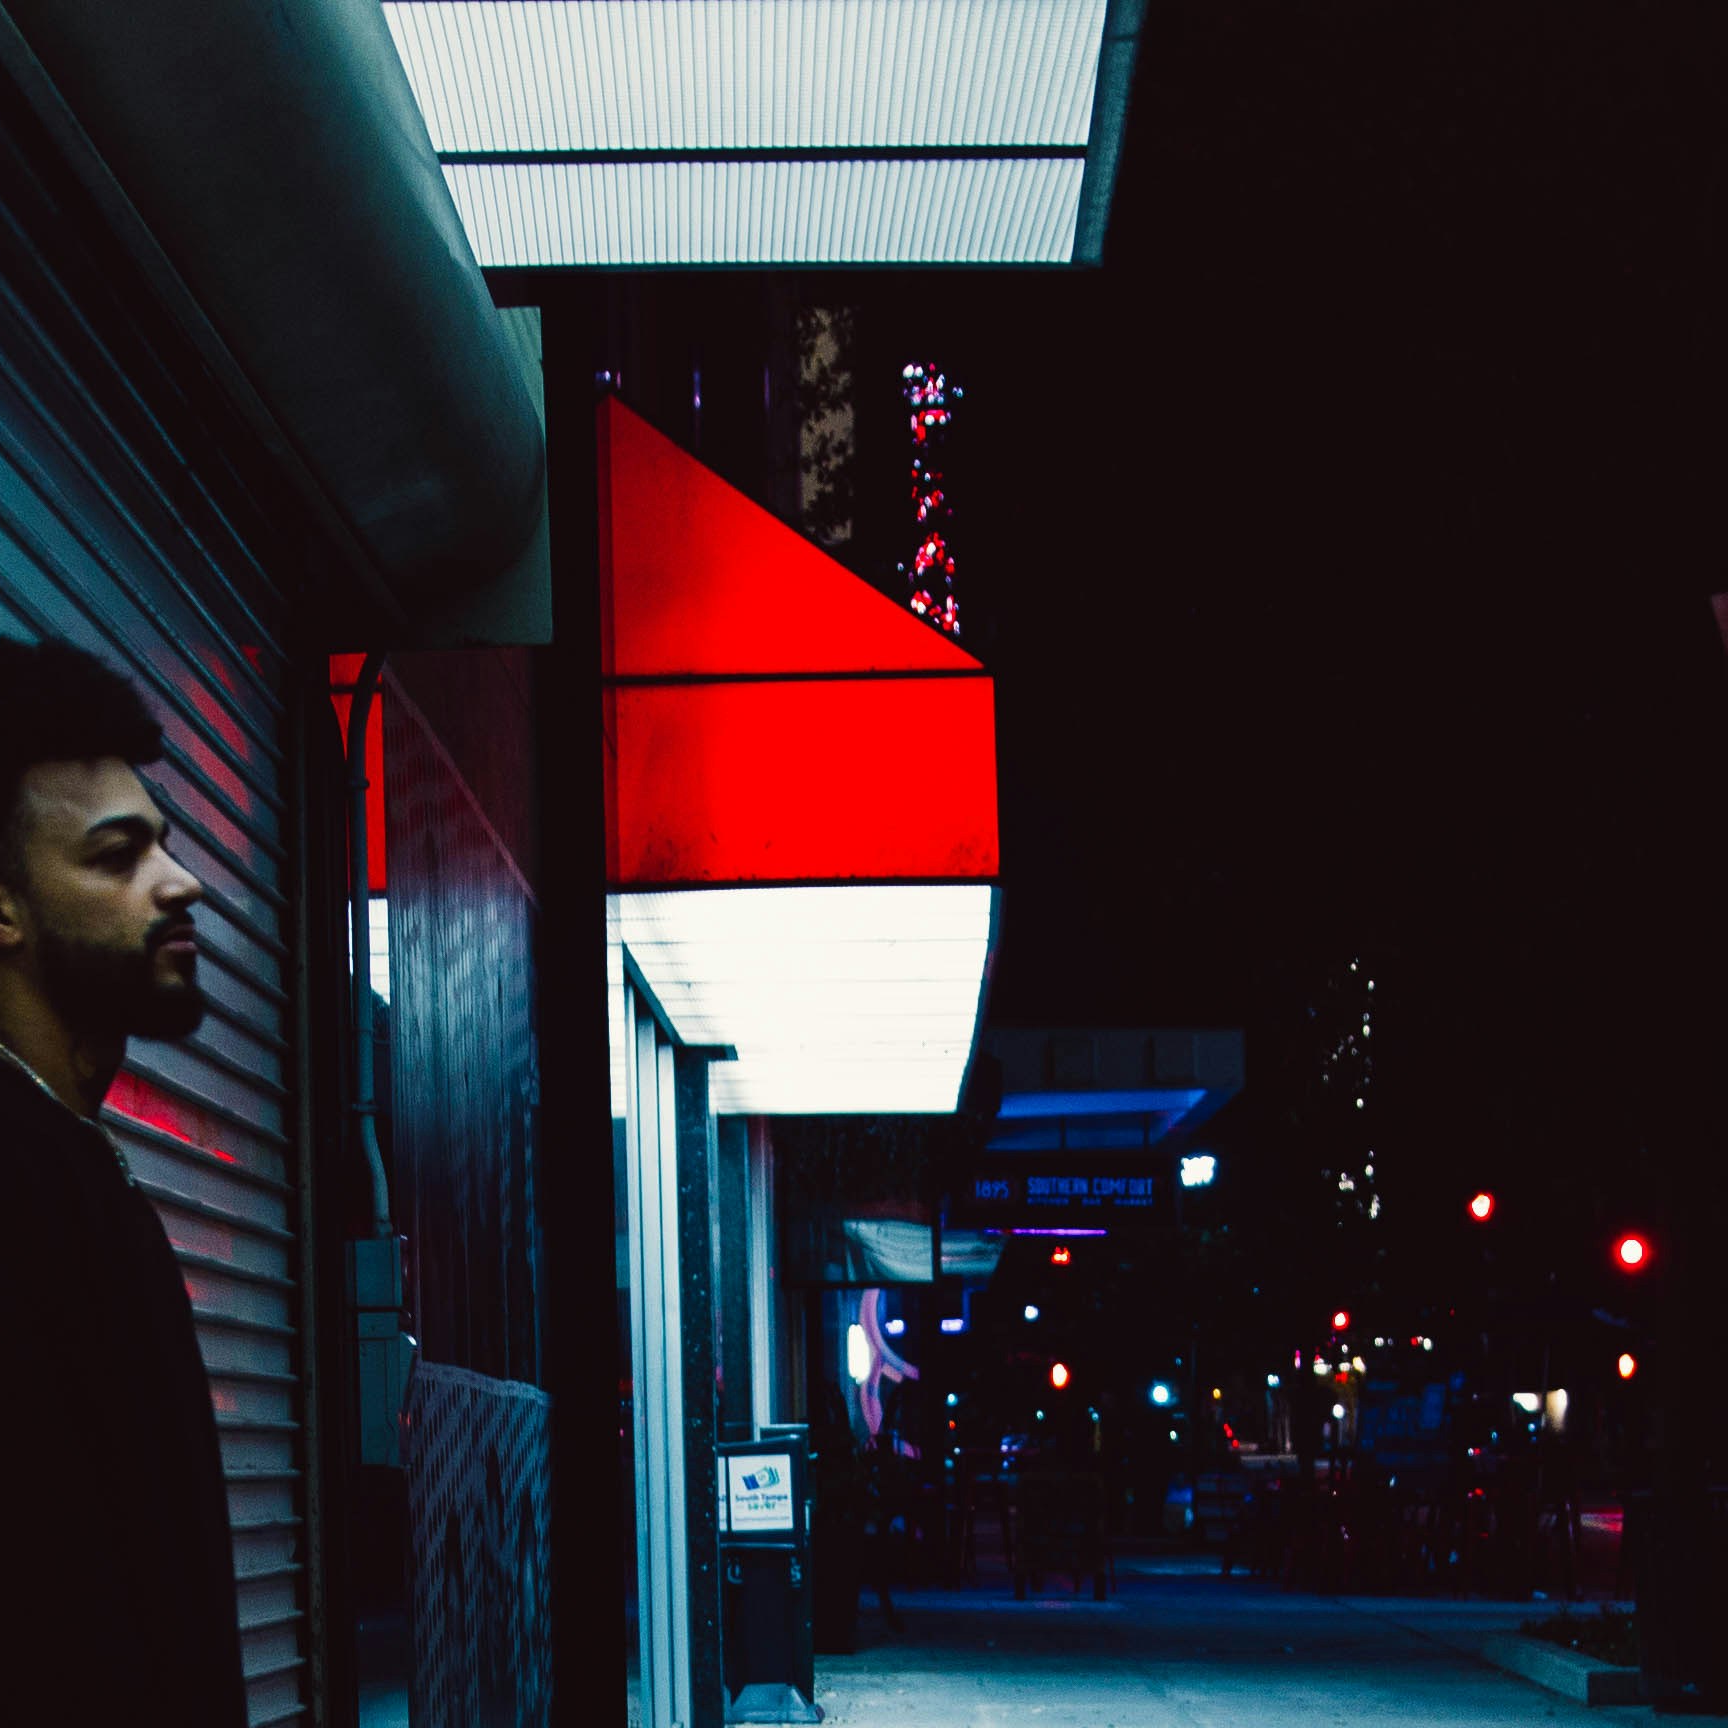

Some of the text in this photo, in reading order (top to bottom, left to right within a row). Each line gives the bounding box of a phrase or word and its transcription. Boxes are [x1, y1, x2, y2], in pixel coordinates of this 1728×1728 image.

[975, 1179, 1010, 1199] 1895
[1026, 1175, 1153, 1196] SOUTHERN COMFORT
